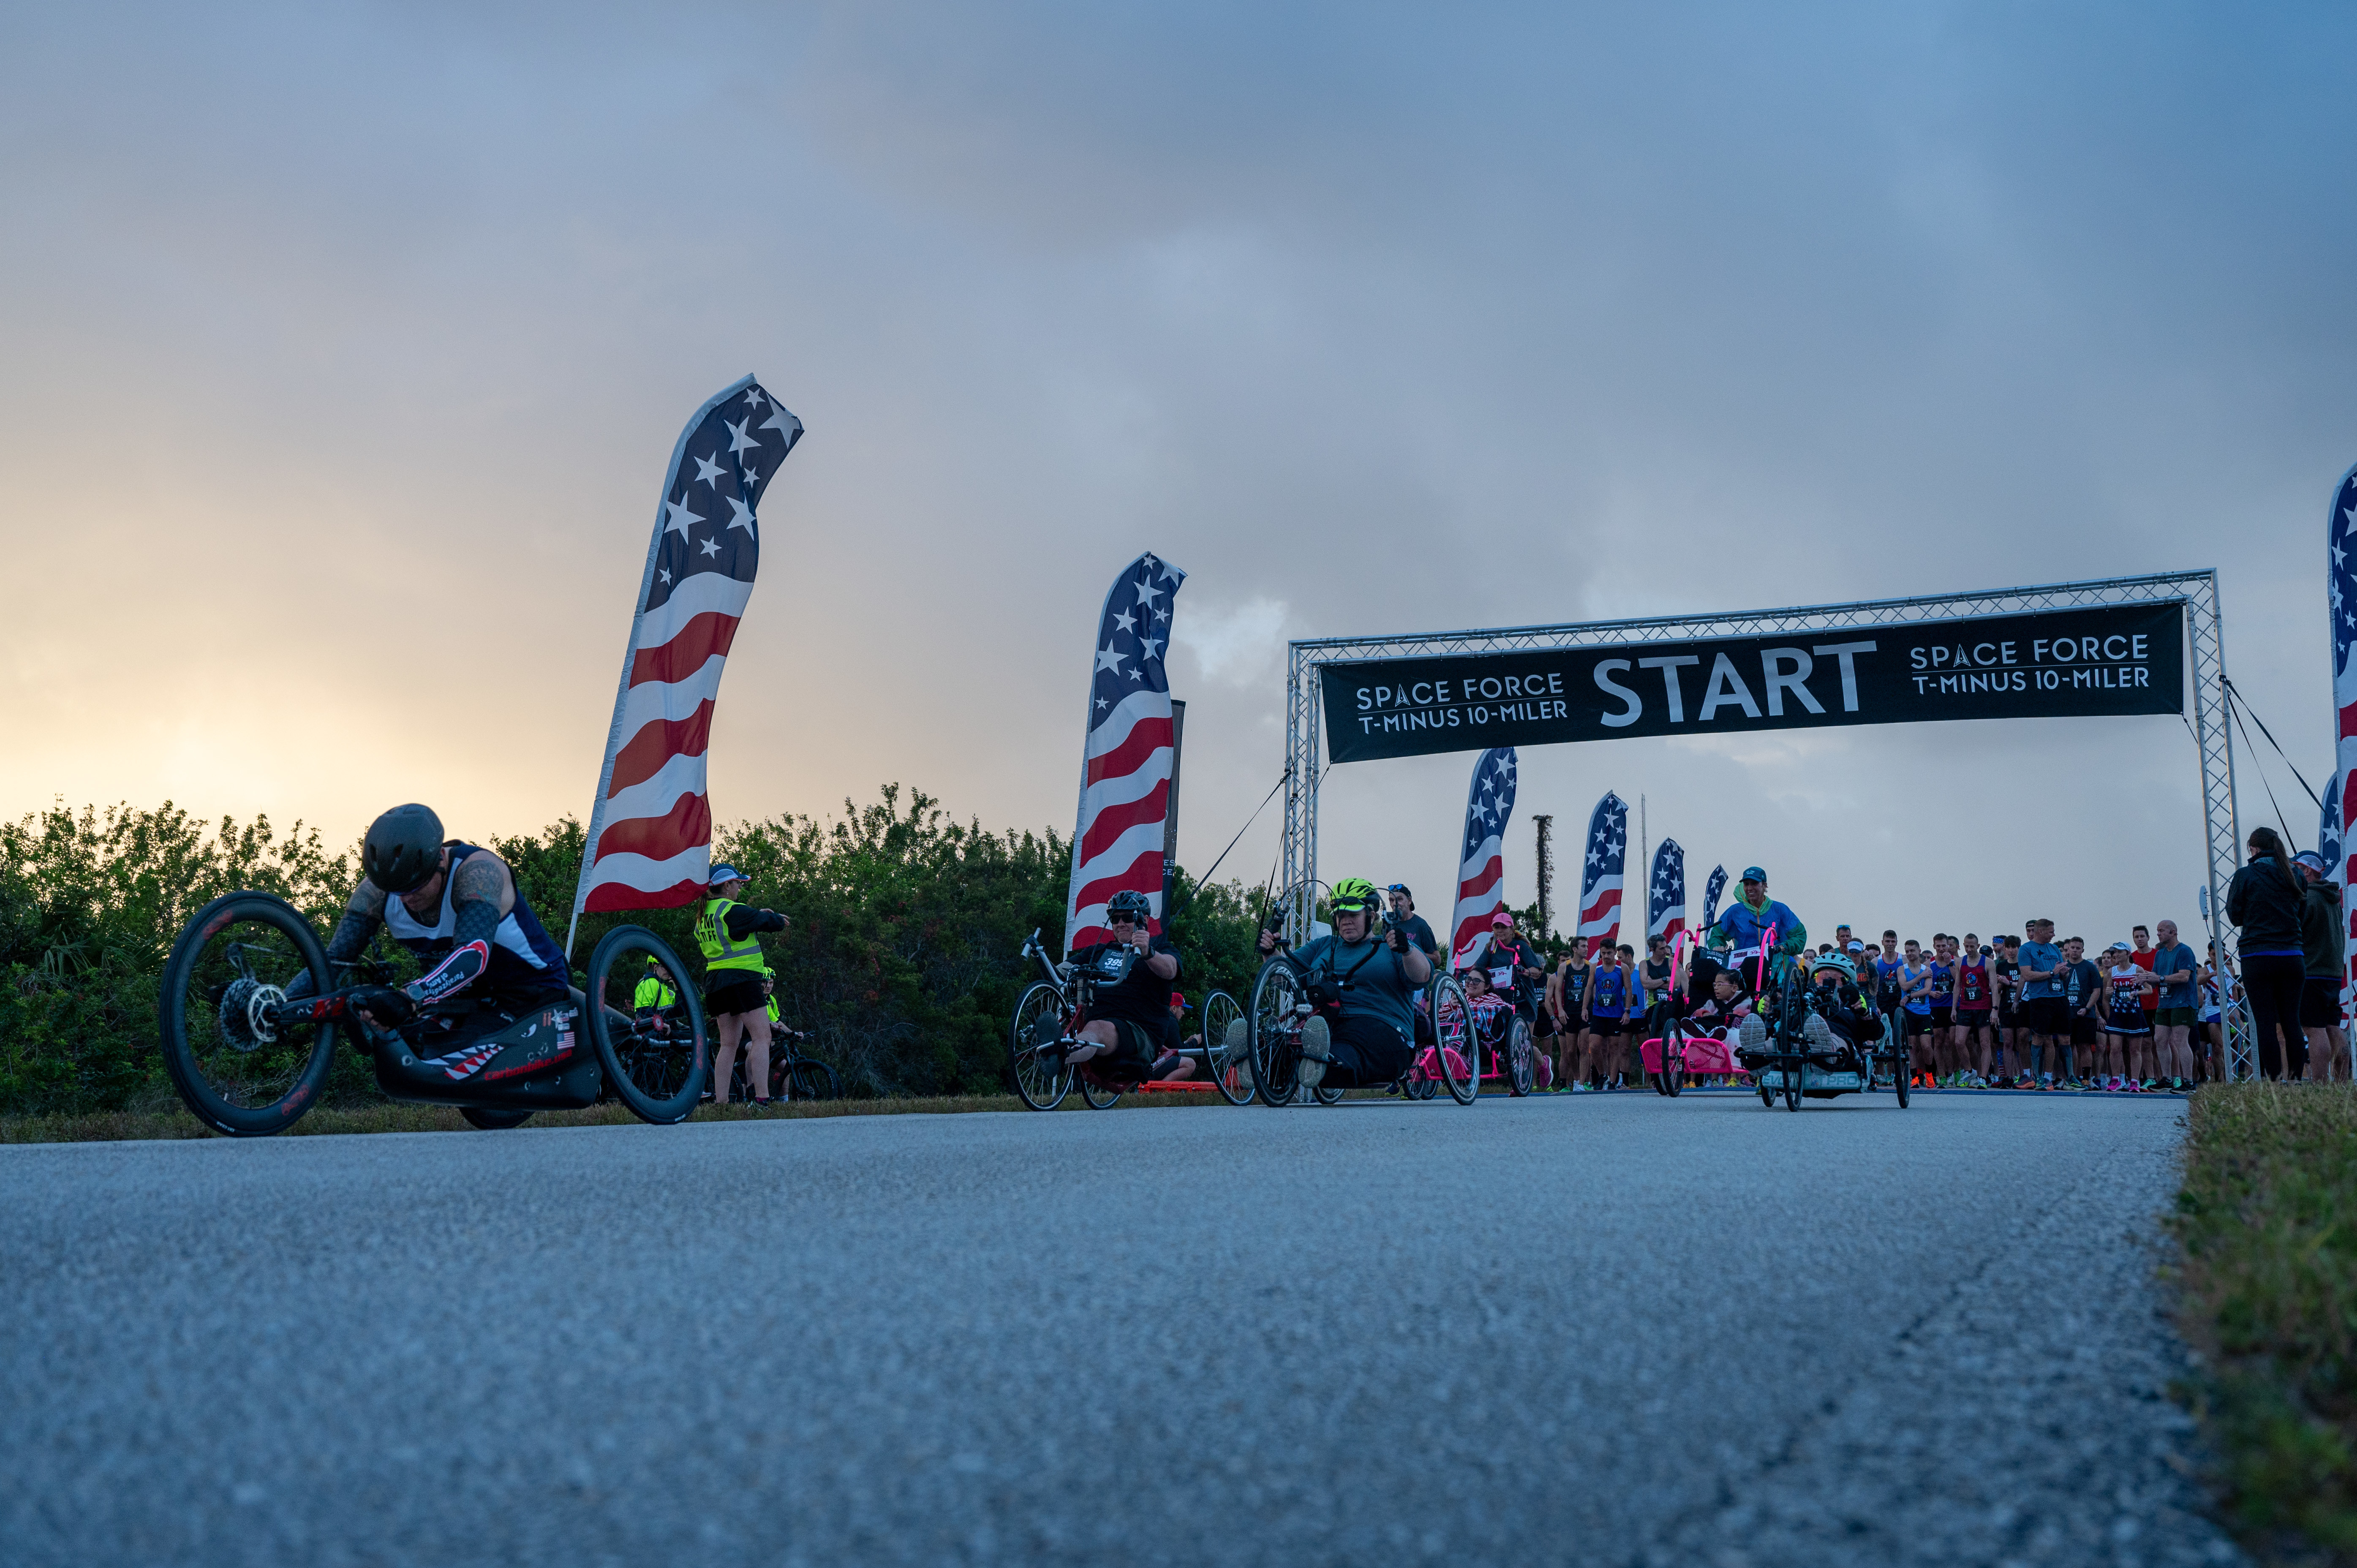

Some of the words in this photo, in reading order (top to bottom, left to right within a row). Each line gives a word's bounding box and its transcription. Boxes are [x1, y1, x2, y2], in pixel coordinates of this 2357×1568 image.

[1911, 641, 2017, 669] SPACE
[2033, 635, 2148, 663] FORCE
[1357, 681, 1451, 710] SPACE
[1463, 673, 1564, 700] FORCE
[1593, 640, 1877, 727] START
[1912, 671, 2026, 695] T-MINUS
[2035, 667, 2149, 690] 10-MILER
[1358, 708, 1460, 734] T-MINUS
[1467, 700, 1568, 725] 10-MILER
[1827, 1076, 1857, 1085] PRO
